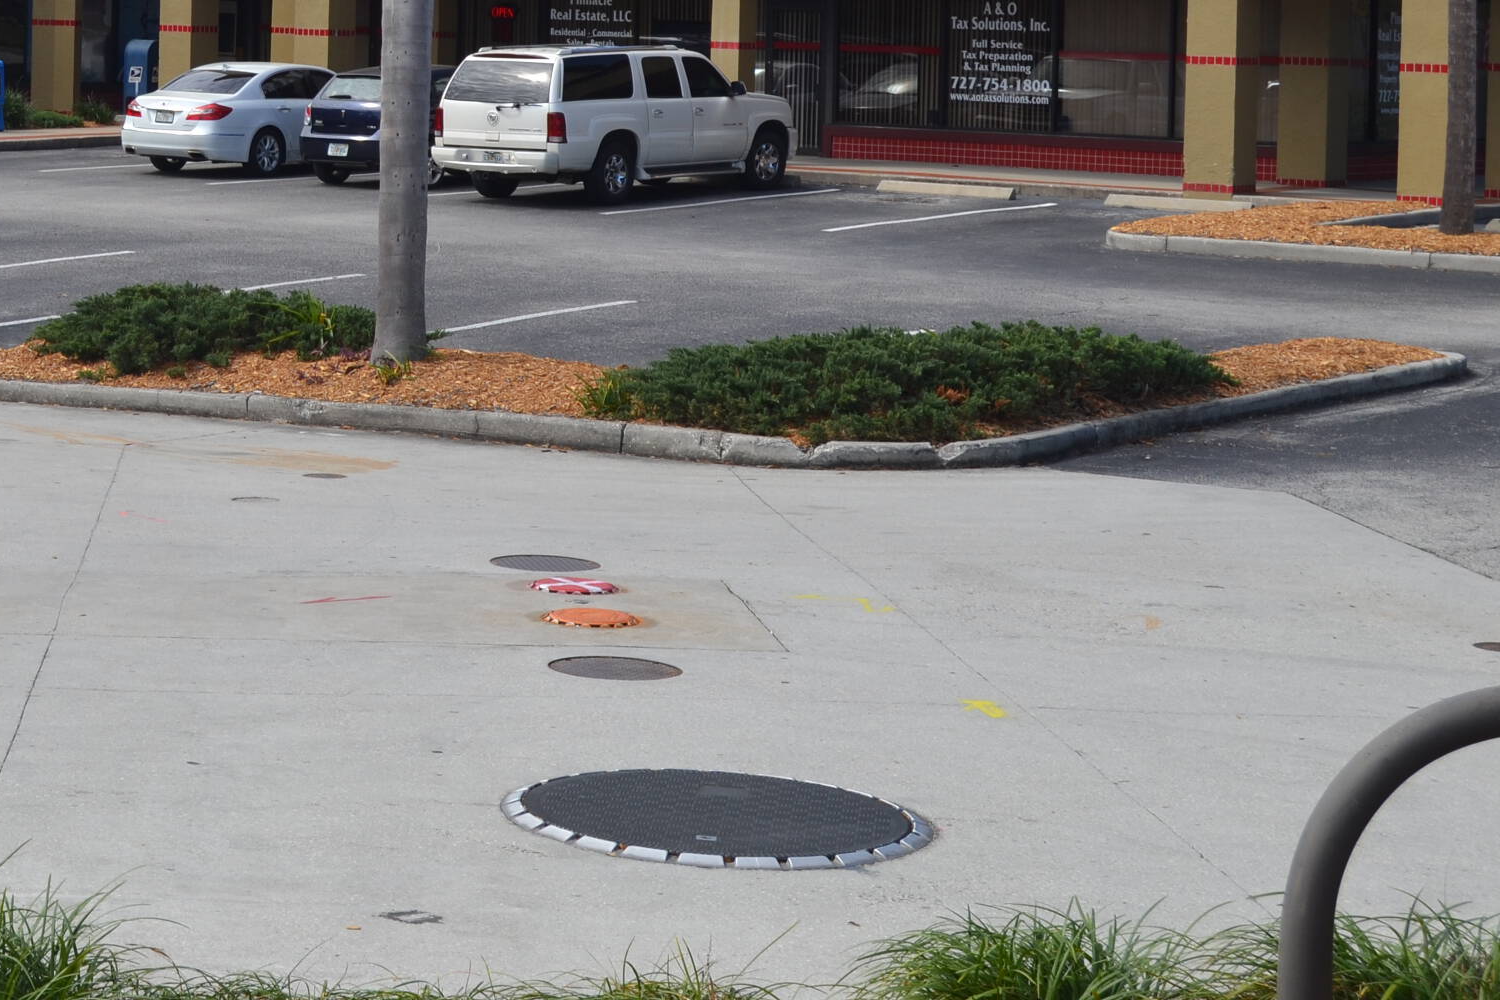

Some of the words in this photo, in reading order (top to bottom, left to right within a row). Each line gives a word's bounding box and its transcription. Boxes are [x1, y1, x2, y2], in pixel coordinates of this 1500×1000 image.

[491, 6, 515, 18] OPEN
[983, 1, 992, 15] A
[994, 2, 1005, 15] &
[1007, 2, 1018, 16] O
[550, 8, 572, 20] Real
[575, 9, 610, 23] Estate,
[613, 10, 632, 22] LLC
[950, 16, 969, 30] Tax
[971, 17, 1027, 32] Solutions,
[1030, 18, 1051, 32] Inc.
[550, 27, 586, 37] Residential
[592, 28, 633, 37] Commercial
[972, 39, 988, 48] Full
[990, 40, 1024, 49] Service
[962, 50, 977, 60] Tax
[979, 51, 1033, 62] Preparation
[963, 62, 972, 71] &
[974, 62, 989, 71] Tax
[991, 62, 1031, 75] Planning
[950, 76, 1051, 92] 727-754-1800
